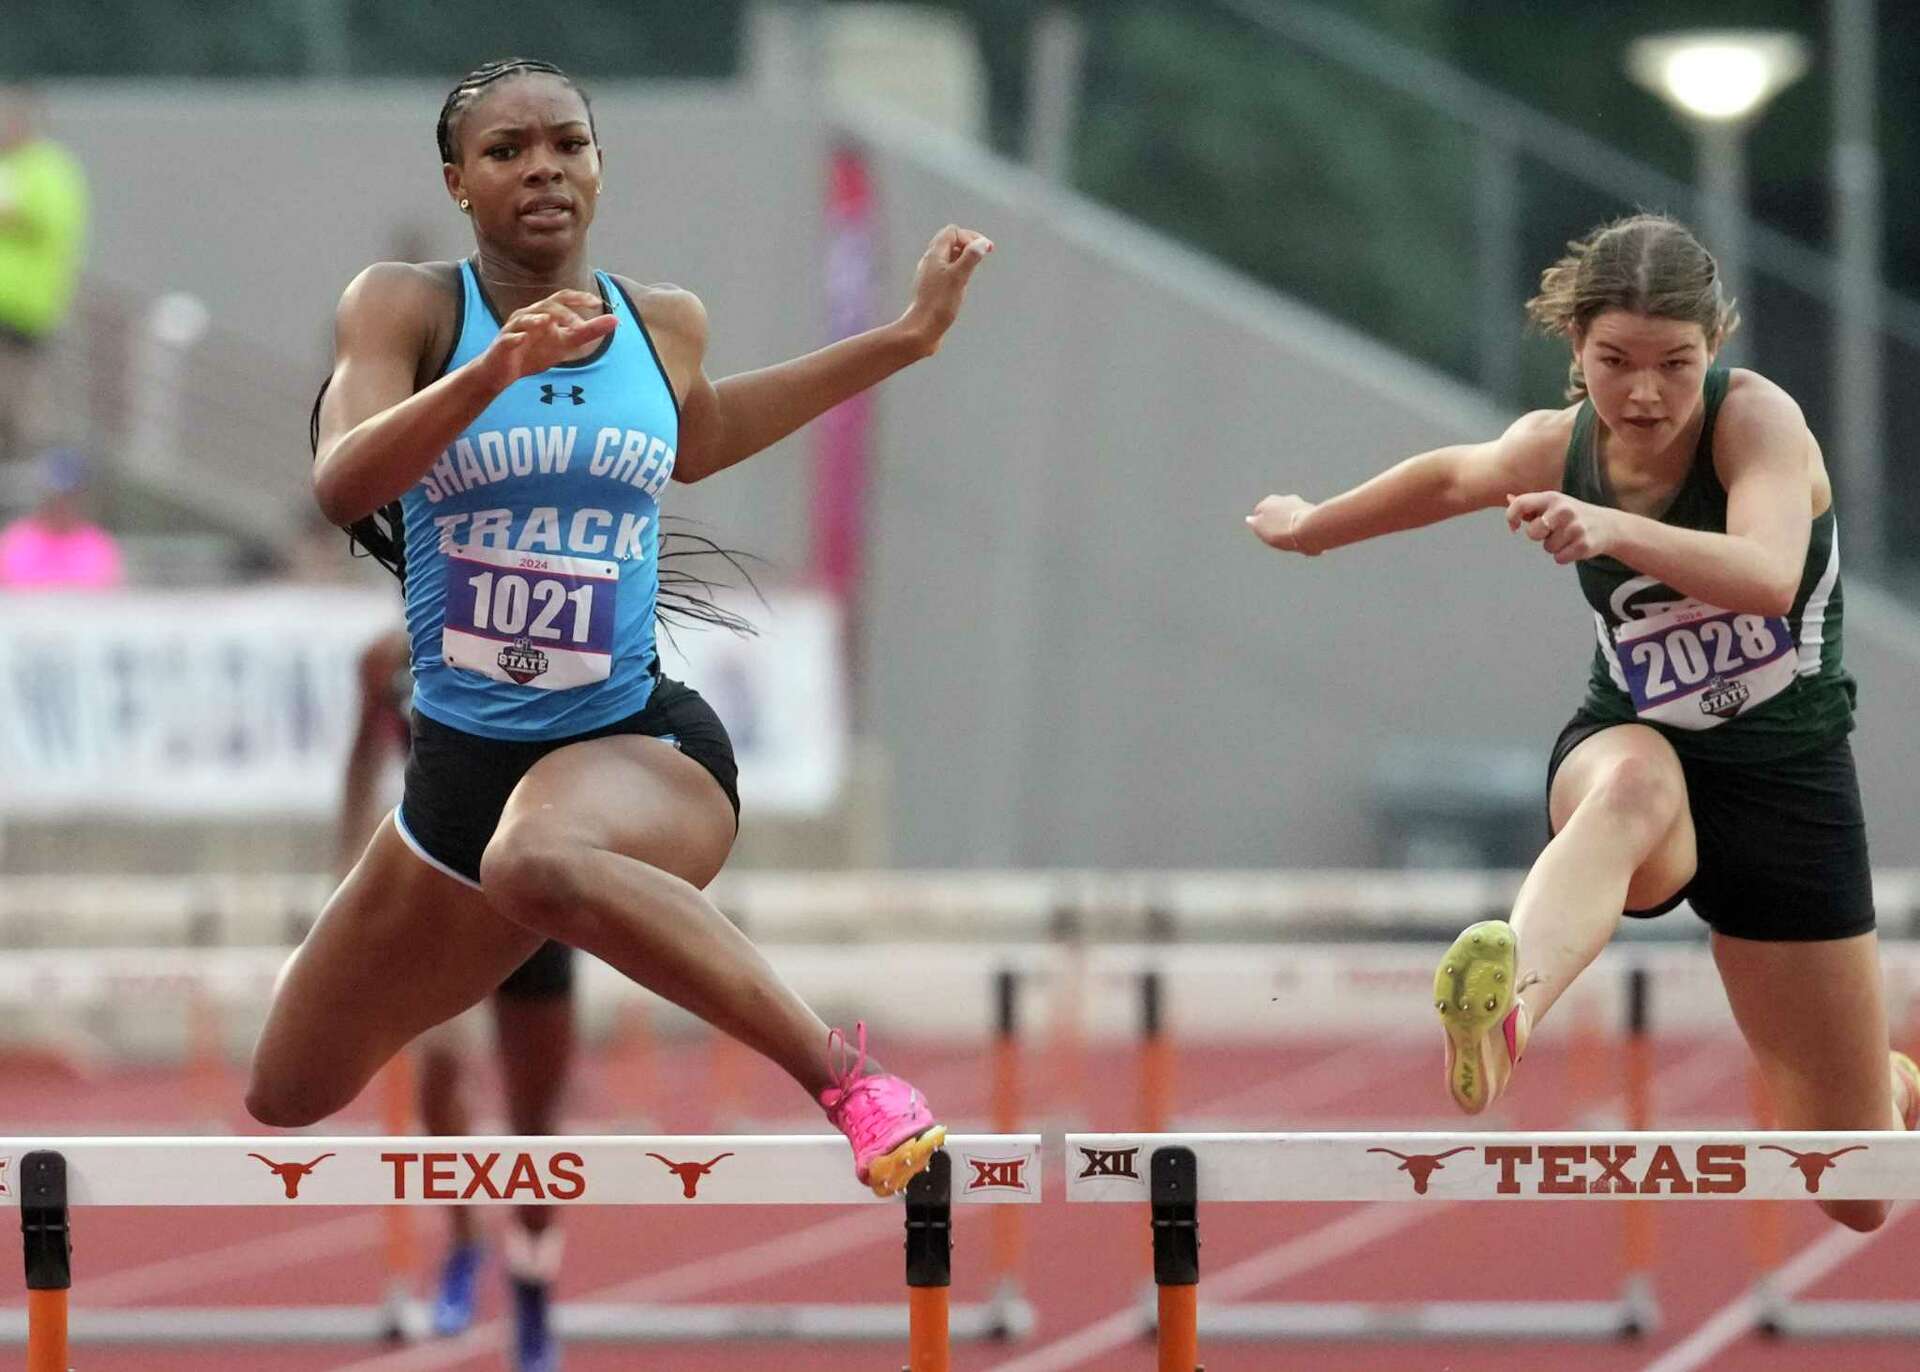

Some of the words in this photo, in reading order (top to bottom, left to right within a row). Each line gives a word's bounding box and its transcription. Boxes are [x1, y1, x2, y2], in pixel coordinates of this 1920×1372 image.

[589, 427, 676, 497] CREE
[434, 507, 649, 560] TRACK
[519, 558, 549, 570] 2024
[468, 571, 594, 643] 1021
[498, 653, 548, 671] STATE
[1631, 613, 1777, 700] 2028
[1700, 685, 1749, 712] STATE
[381, 1152, 586, 1199] TEXAS
[969, 1159, 1025, 1189] XII
[1079, 1147, 1139, 1179] XII
[1484, 1144, 1747, 1193] TEXAS
